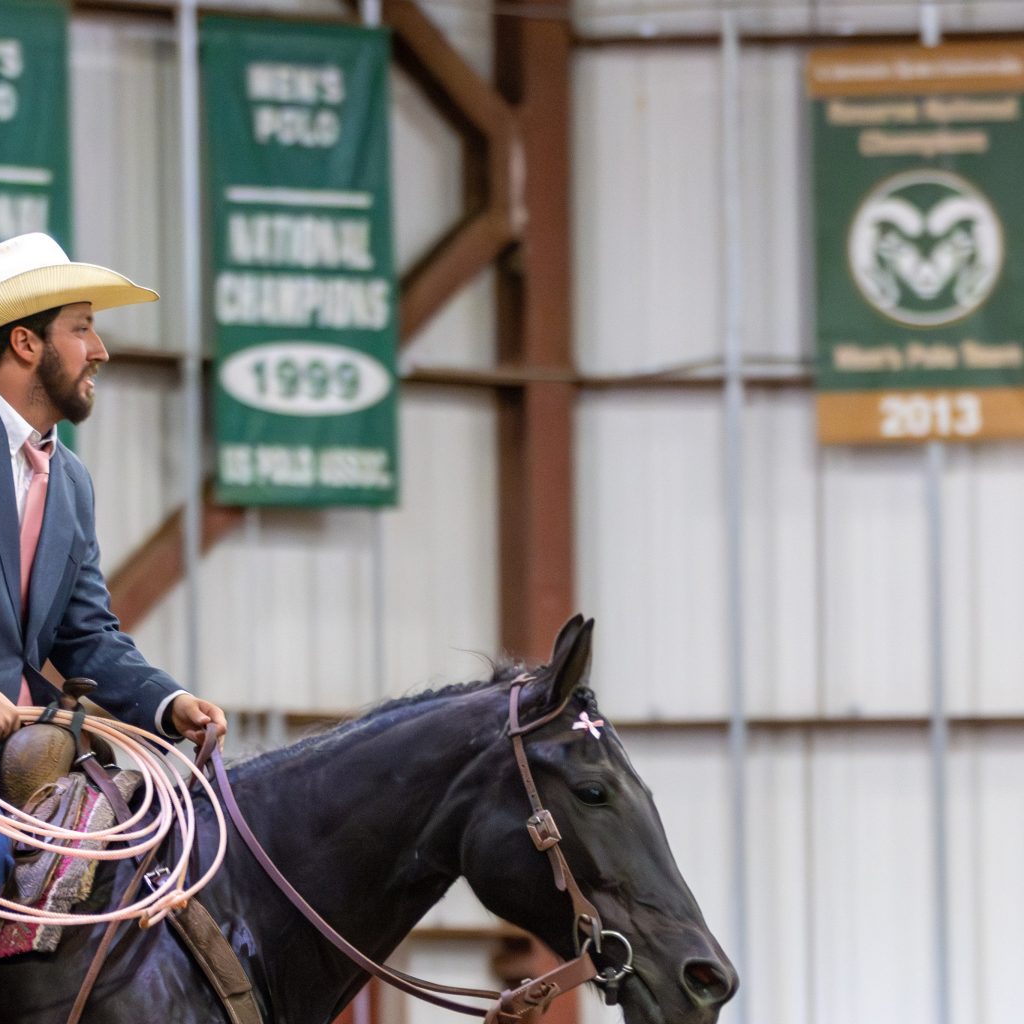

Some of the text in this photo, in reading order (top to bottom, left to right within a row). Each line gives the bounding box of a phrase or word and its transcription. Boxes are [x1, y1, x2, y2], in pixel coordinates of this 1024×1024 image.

[248, 64, 343, 103] MEN'S
[255, 107, 337, 146] POLO
[229, 214, 370, 268] NATIONAL
[217, 274, 388, 329] CHAMPIONS
[250, 360, 360, 401] 1999
[880, 393, 983, 437] 2013
[221, 444, 251, 485] US
[258, 446, 311, 485] POLO
